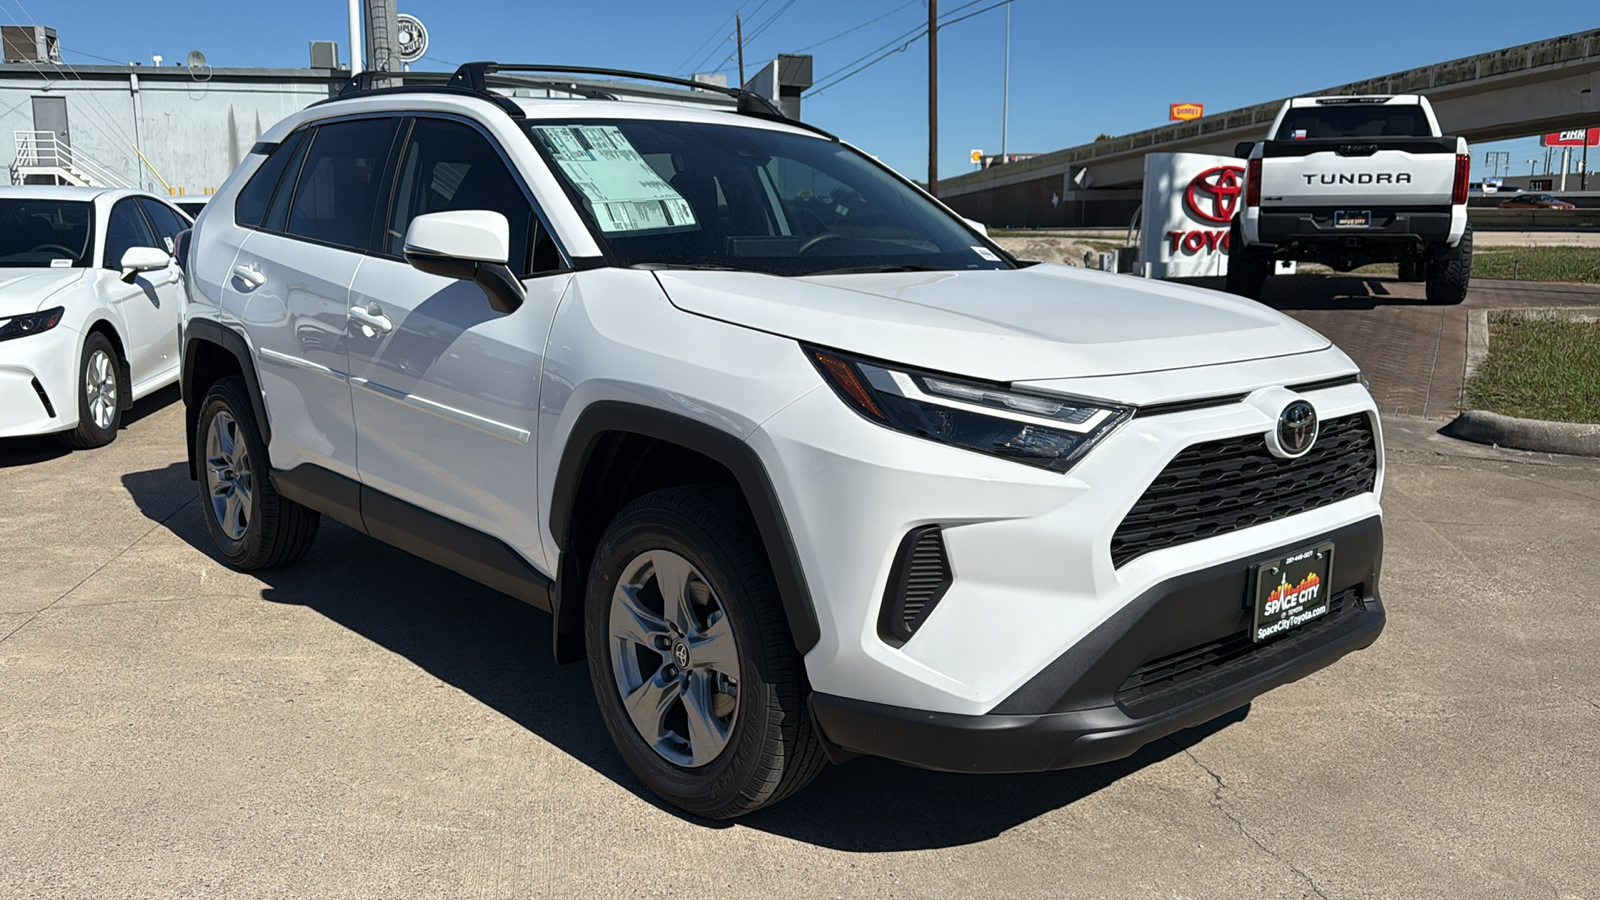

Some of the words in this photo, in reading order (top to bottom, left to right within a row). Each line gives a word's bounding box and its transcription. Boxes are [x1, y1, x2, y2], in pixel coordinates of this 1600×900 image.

[1302, 173, 1412, 185] TUNDRA
[1263, 592, 1299, 617] SPACE
[1298, 584, 1320, 604] CITY
[1257, 605, 1326, 639] SpaceCityToyota.com
